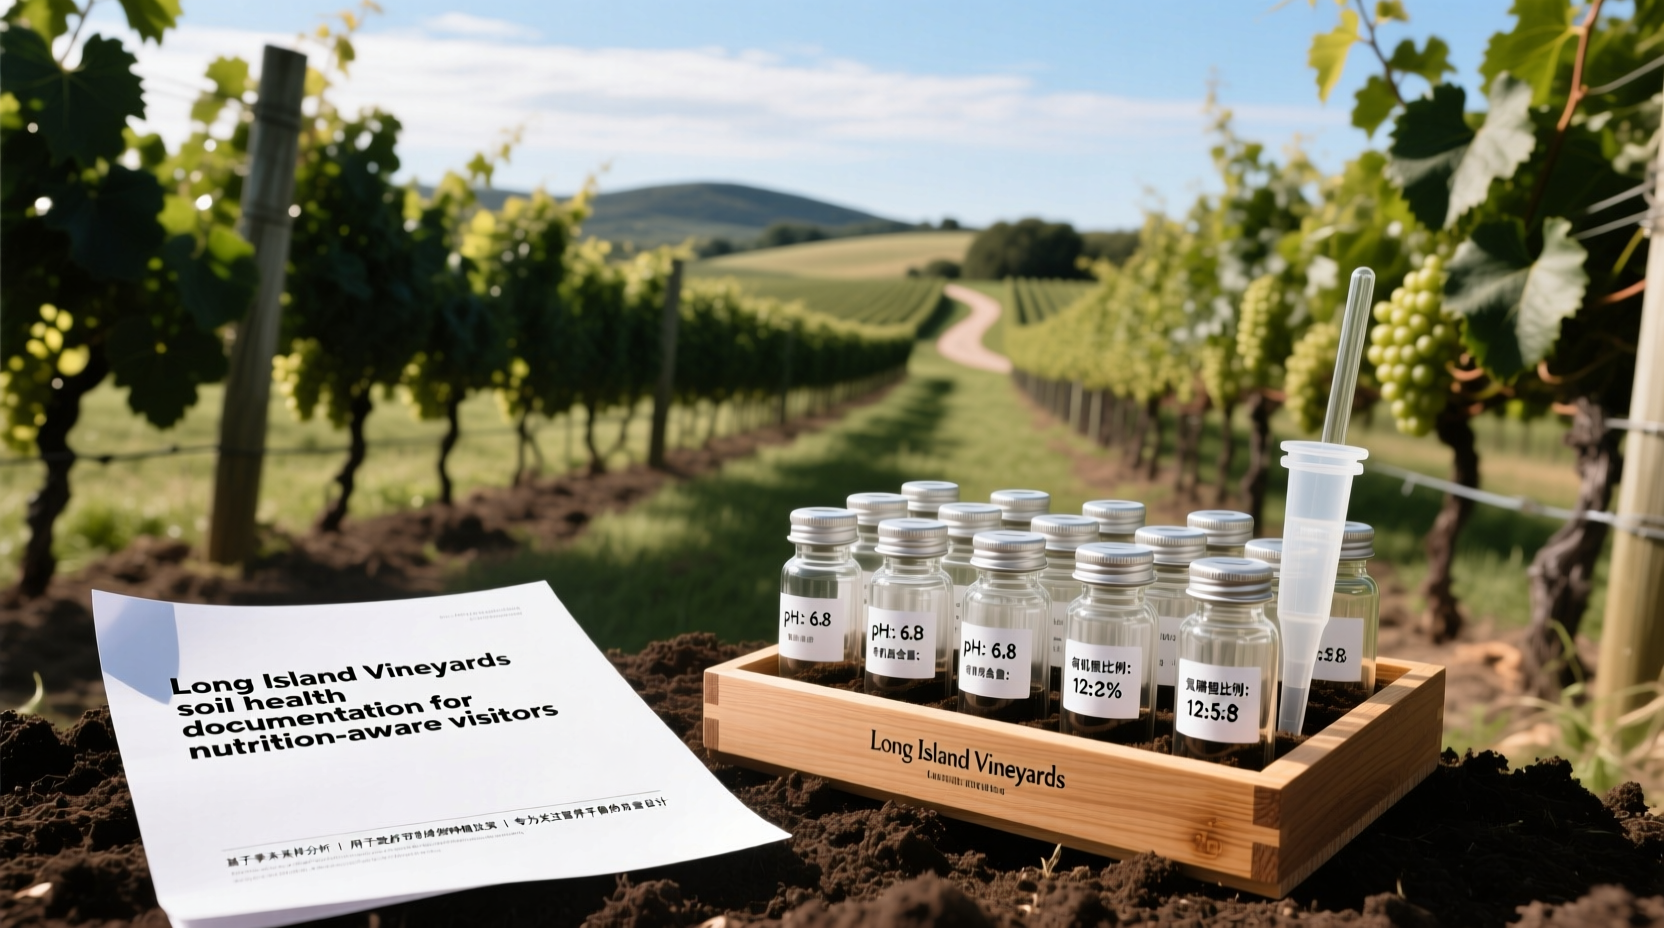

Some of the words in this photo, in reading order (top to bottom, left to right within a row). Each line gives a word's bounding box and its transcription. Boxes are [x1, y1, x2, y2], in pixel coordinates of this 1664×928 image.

[784, 610, 805, 627] pH:
[809, 611, 831, 627] 6.8
[872, 623, 896, 641] pH:
[900, 625, 924, 641] 6.8
[964, 638, 986, 657] pH:
[991, 643, 1017, 659] 6.8
[170, 677, 254, 695] Long
[262, 667, 357, 689] Island
[363, 652, 511, 680] Vineyards
[1073, 677, 1122, 699] 12:2%
[177, 697, 234, 717] soil
[244, 688, 347, 712] health
[1187, 699, 1239, 723] 12:5:8
[182, 699, 424, 739] documentation
[429, 693, 473, 709] for
[189, 717, 442, 760] nutrition-aware
[448, 703, 559, 728] visitors
[870, 729, 913, 764] Long
[917, 738, 970, 770] Island
[974, 751, 1065, 789] Vineyards
